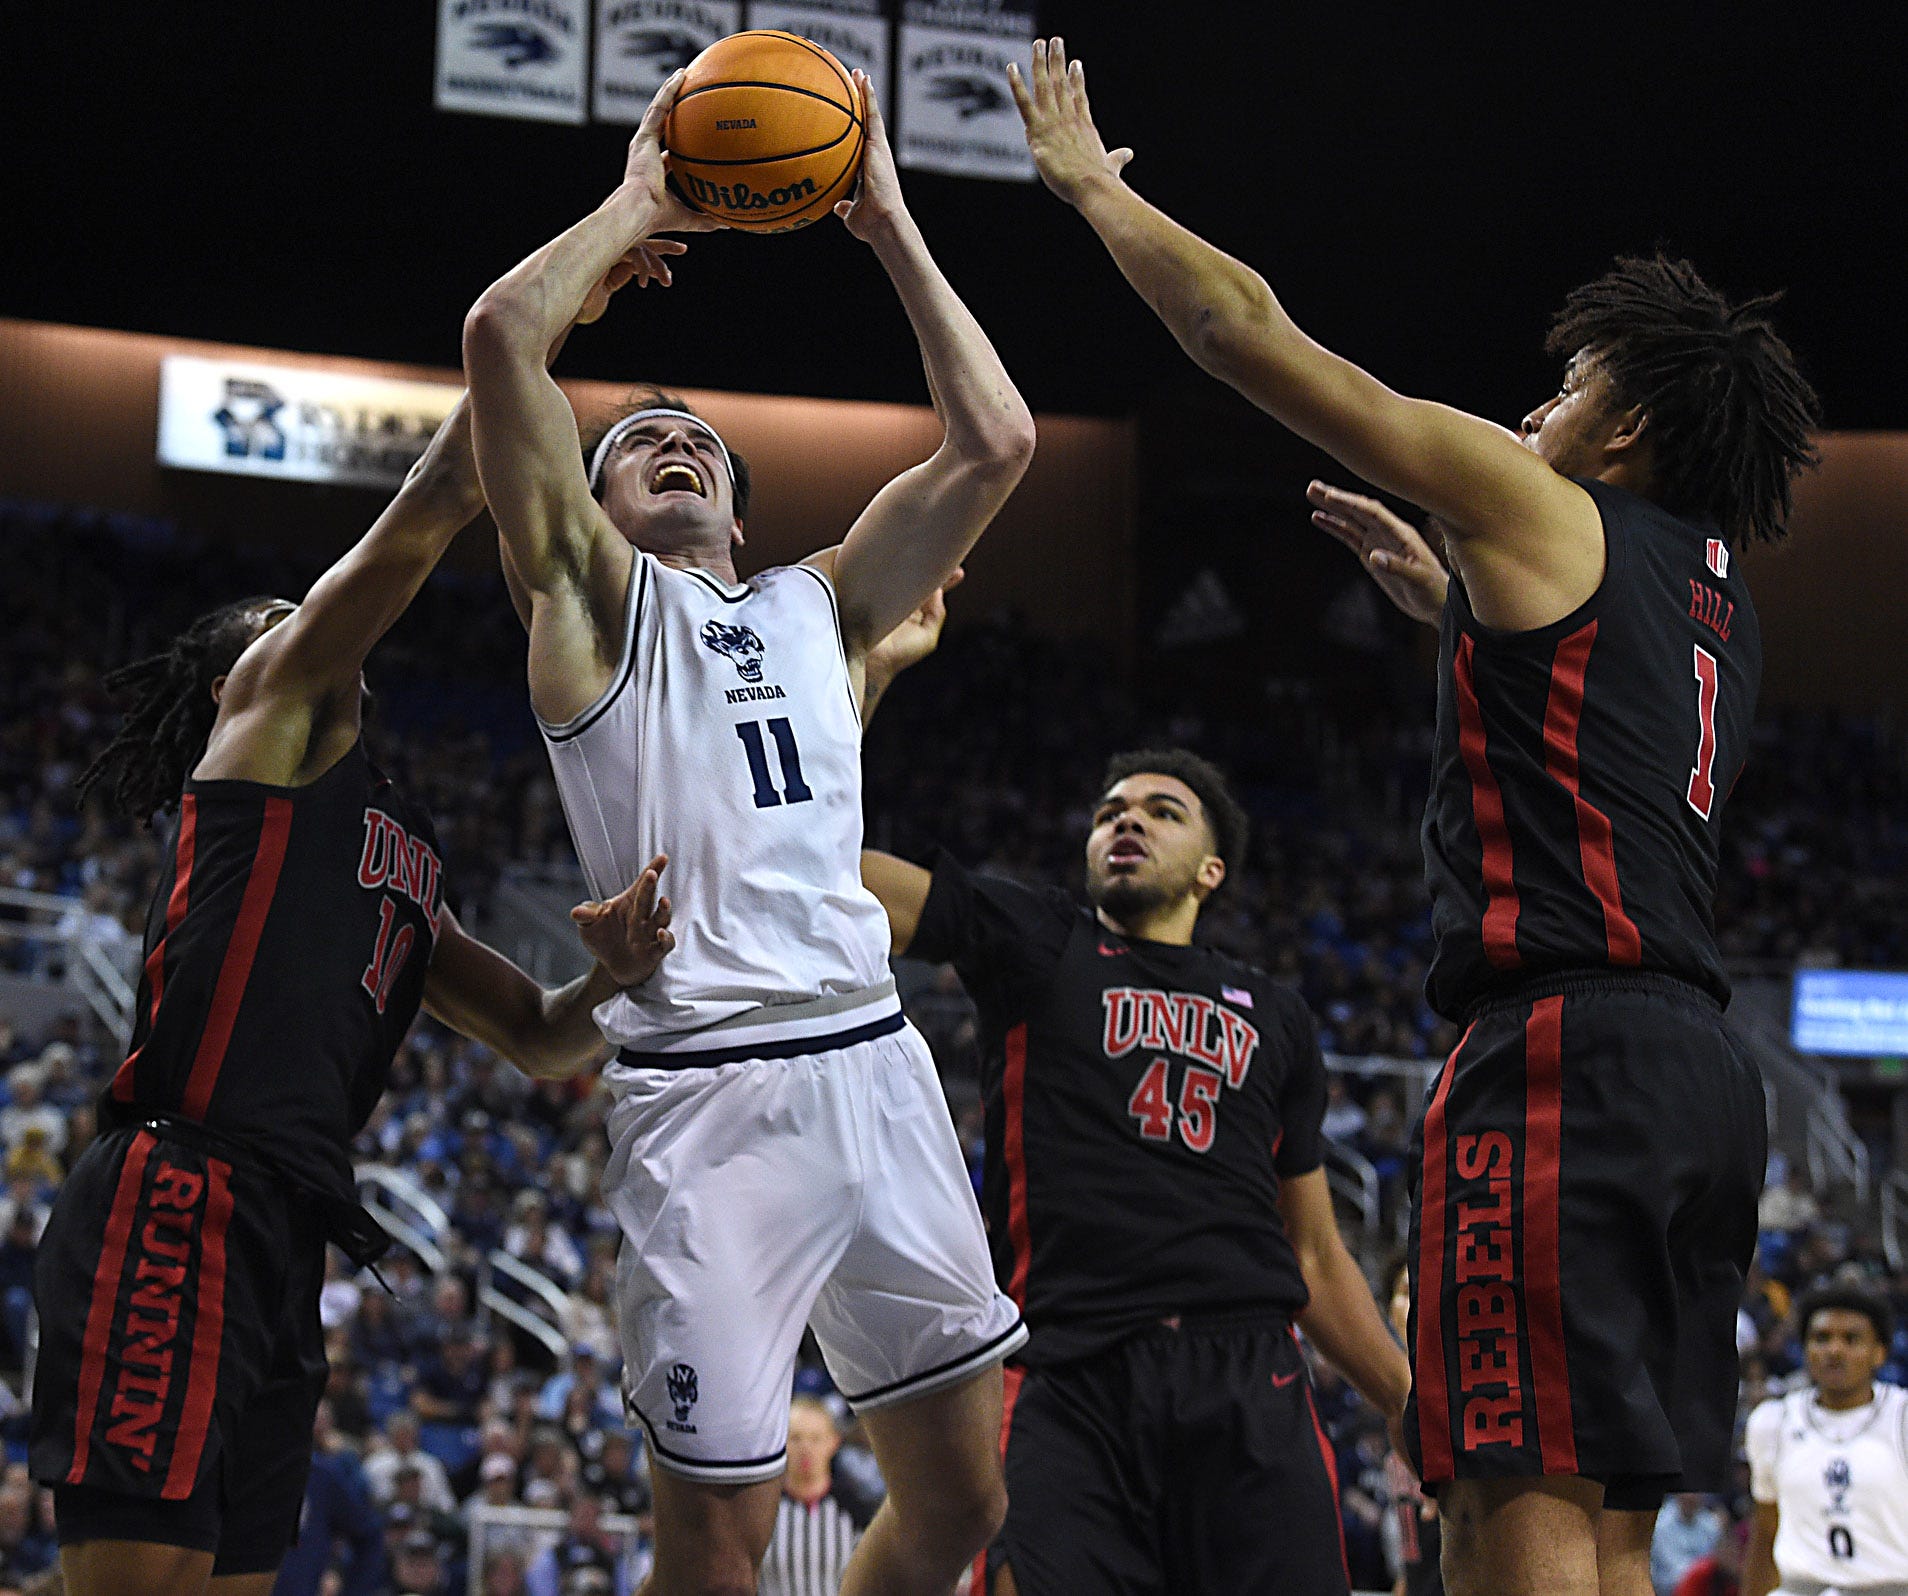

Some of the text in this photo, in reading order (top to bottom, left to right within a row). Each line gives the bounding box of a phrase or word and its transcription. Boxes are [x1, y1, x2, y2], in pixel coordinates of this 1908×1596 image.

[716, 119, 757, 131] NEVADA
[685, 171, 818, 210] Wilson
[1688, 578, 1734, 642] HILL
[724, 685, 787, 705] NEVADA
[1687, 643, 1718, 822] 1
[735, 717, 814, 809] 11
[358, 807, 442, 946] UNL
[361, 894, 415, 1016] 10
[1102, 986, 1261, 1090] UNLV
[1128, 1057, 1222, 1153] 45
[1456, 1130, 1523, 1450] REBELS
